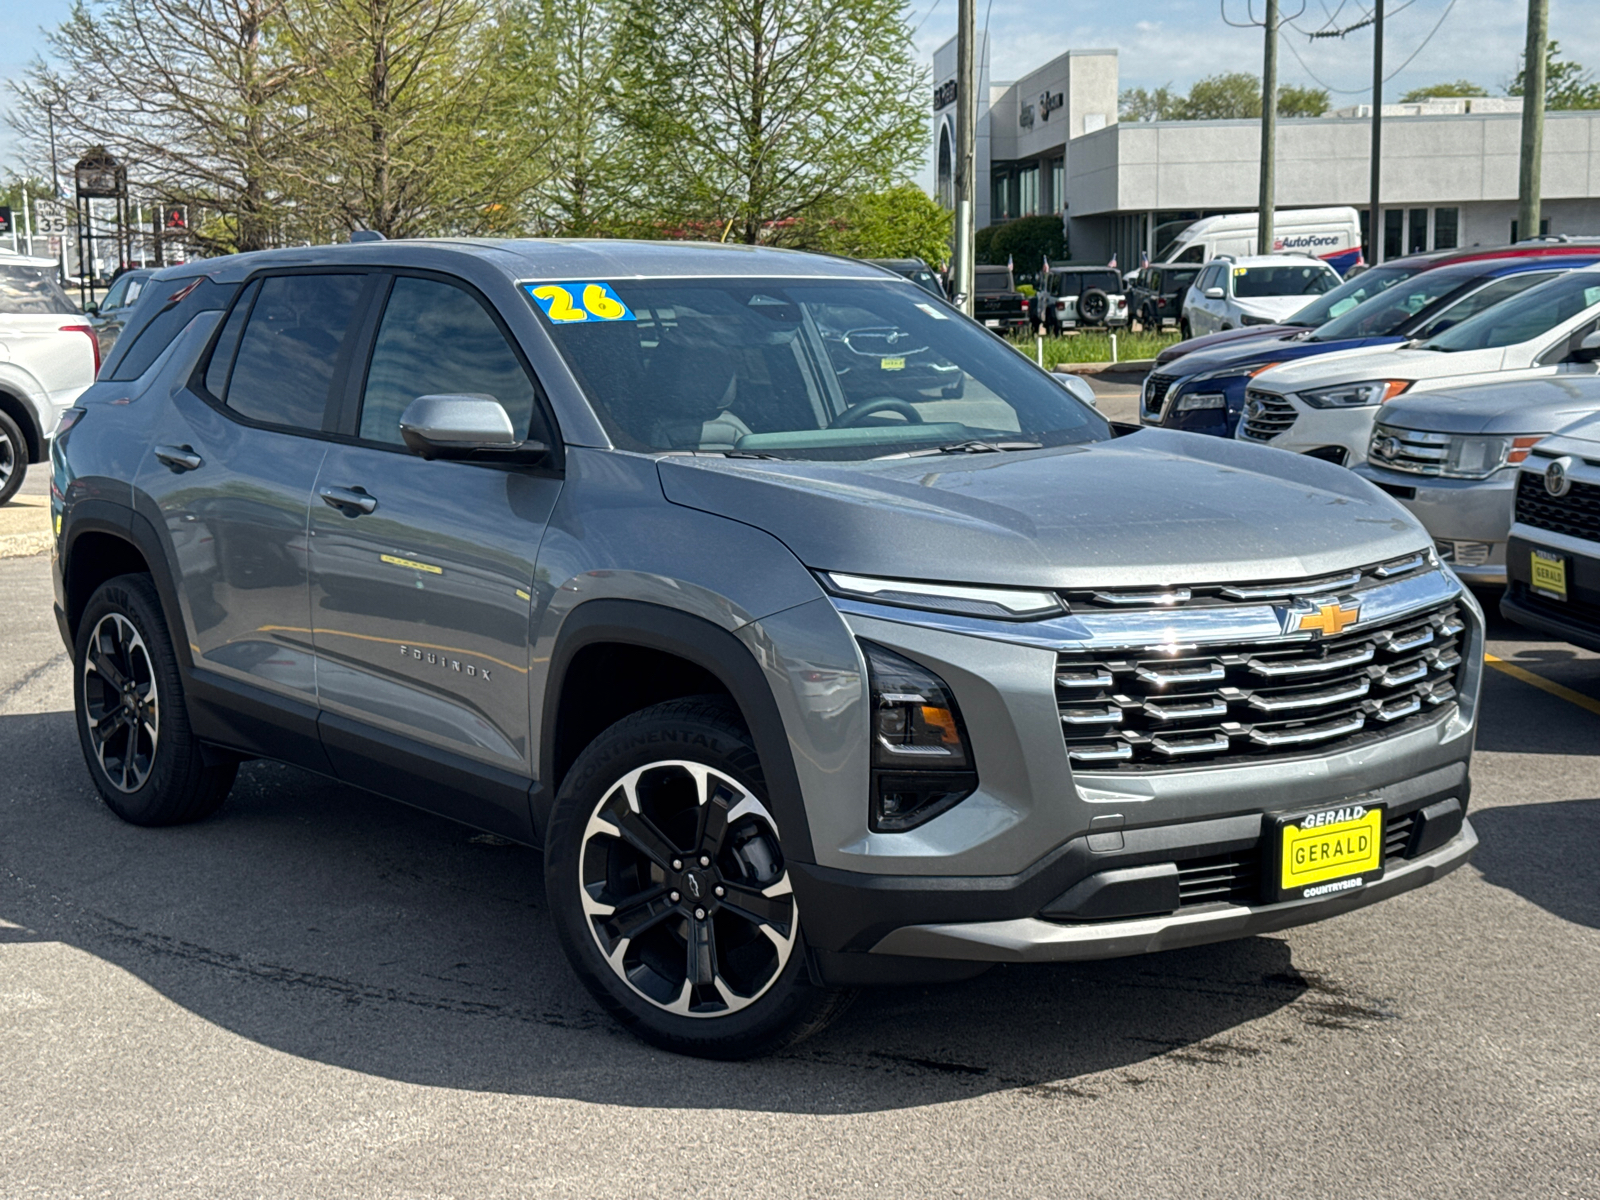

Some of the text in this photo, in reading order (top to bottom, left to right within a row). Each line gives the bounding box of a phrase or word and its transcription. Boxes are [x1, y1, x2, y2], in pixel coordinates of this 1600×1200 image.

[40, 218, 66, 232] 35
[1282, 235, 1339, 248] AutoForce
[531, 284, 626, 322] 26
[1536, 566, 1562, 583] GERALD
[400, 645, 491, 681] EQUINOX
[574, 729, 723, 792] CONTINENTAL
[1304, 805, 1364, 828] GERALD
[1295, 835, 1368, 865] GERALD
[1303, 877, 1363, 898] COUNTRYSIDE
